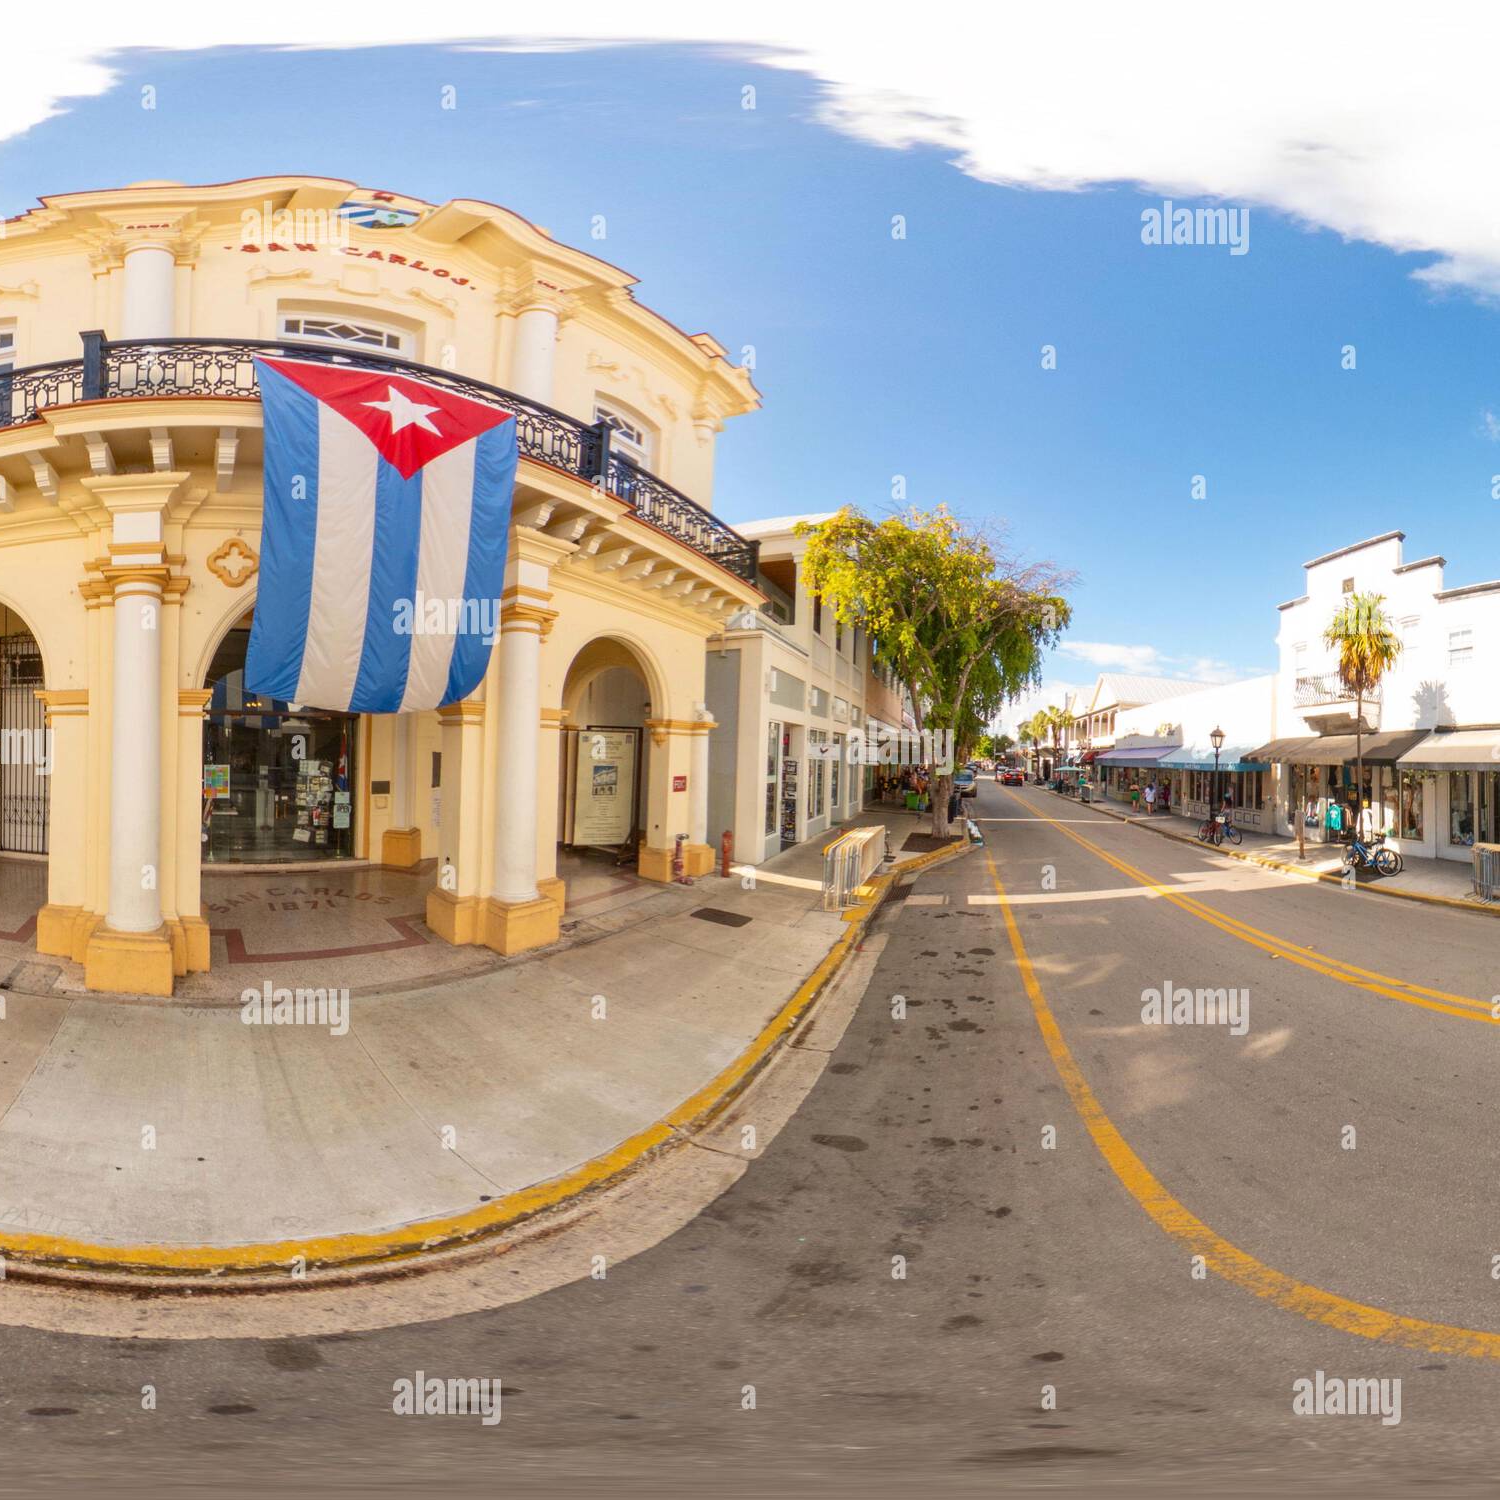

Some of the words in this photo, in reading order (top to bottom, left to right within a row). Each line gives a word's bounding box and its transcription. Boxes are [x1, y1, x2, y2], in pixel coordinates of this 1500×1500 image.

[241, 243, 318, 253] SAN
[208, 891, 261, 914] SAN
[266, 887, 395, 905] CARLOS
[267, 899, 336, 912] 1871
